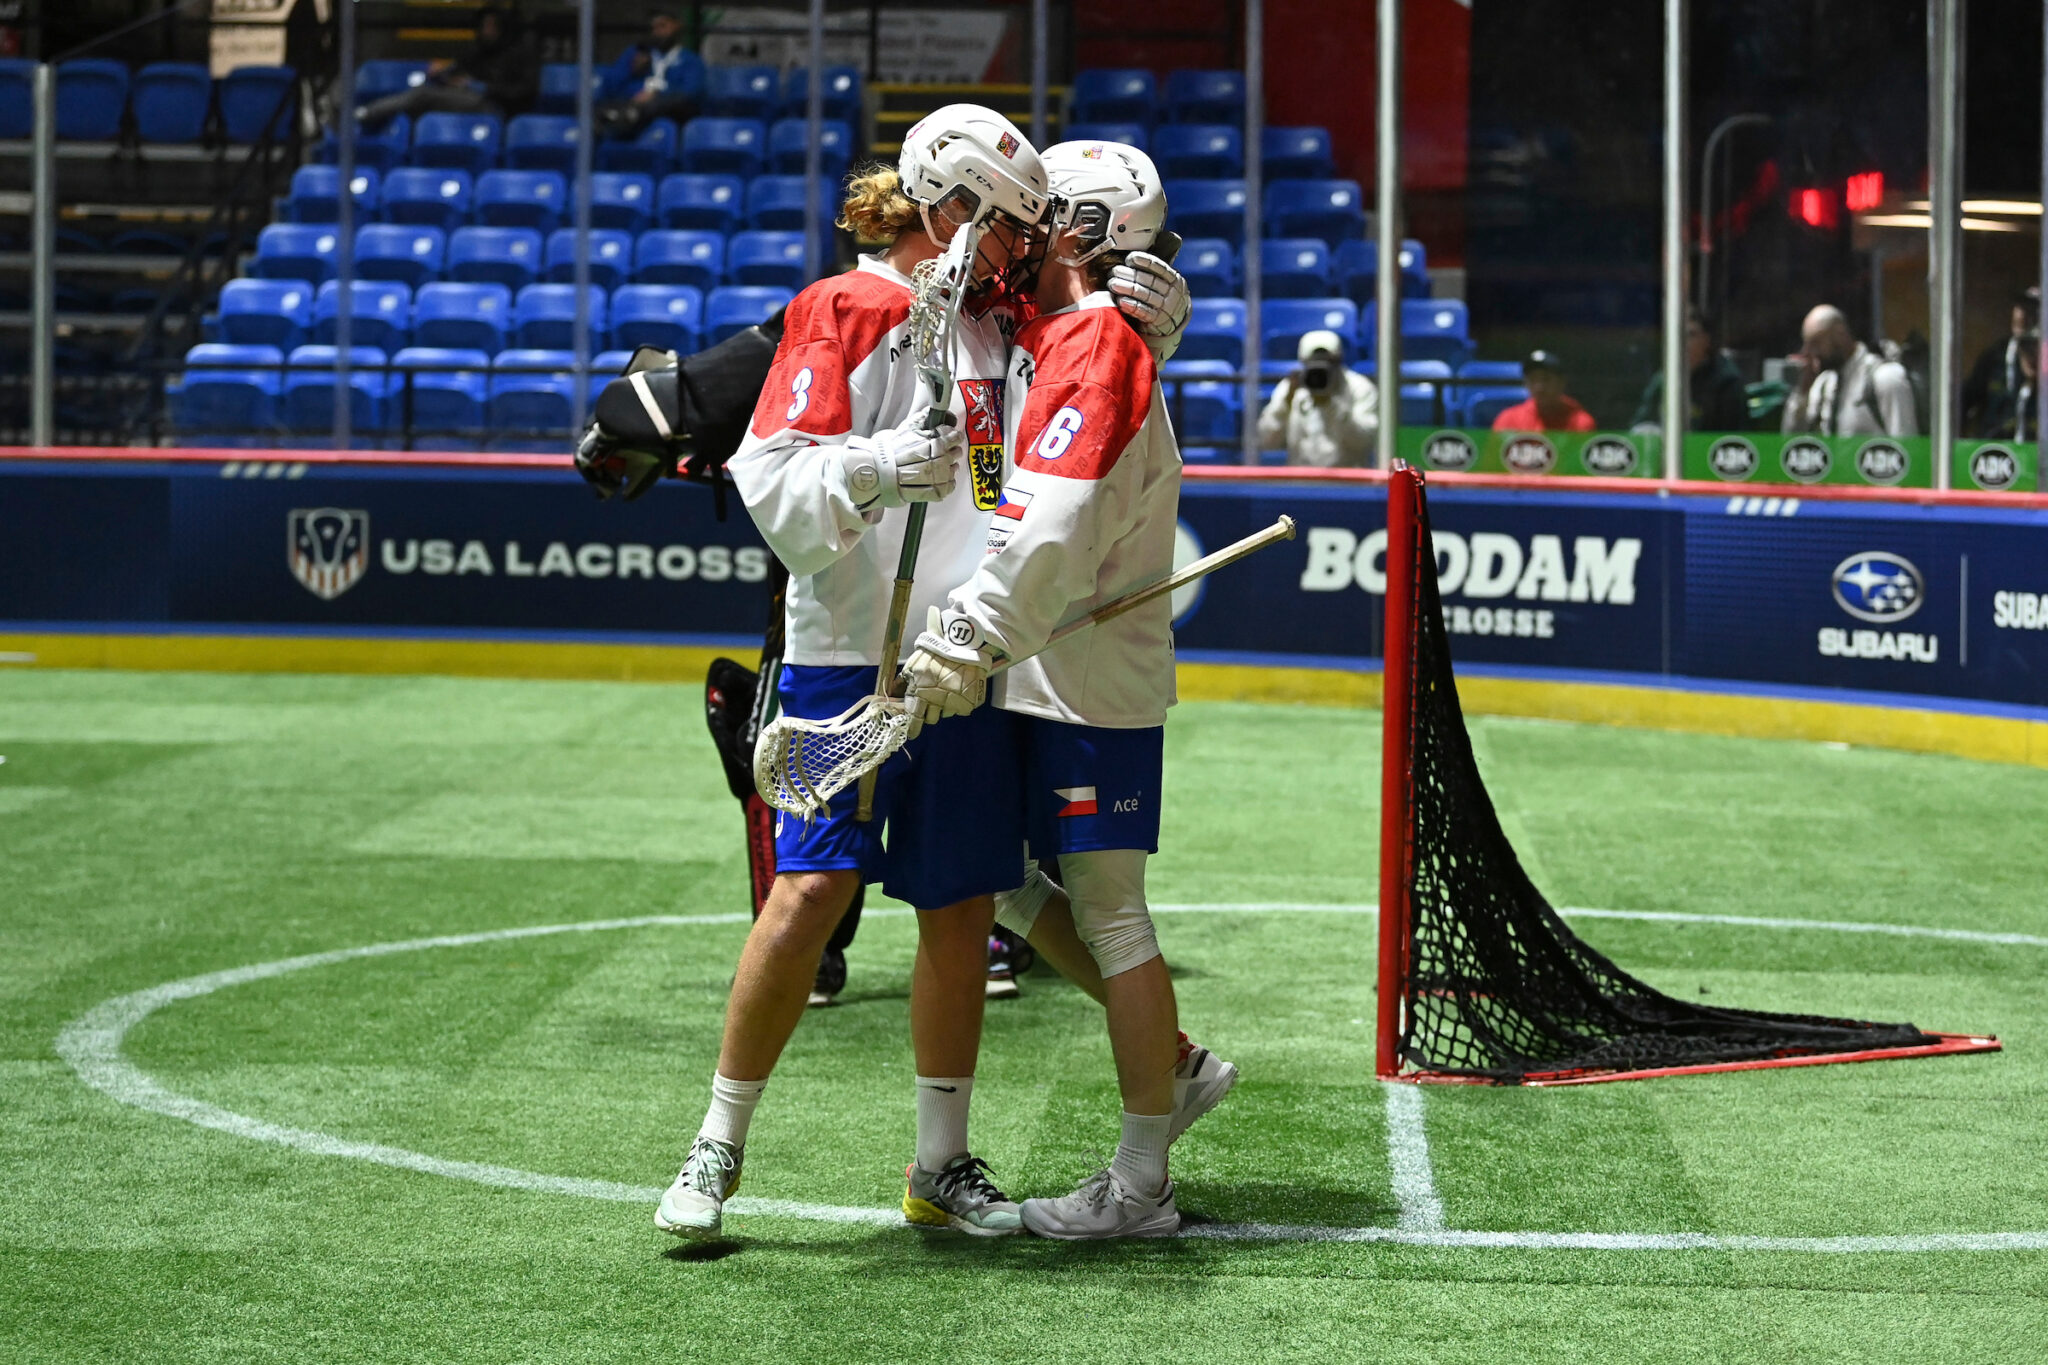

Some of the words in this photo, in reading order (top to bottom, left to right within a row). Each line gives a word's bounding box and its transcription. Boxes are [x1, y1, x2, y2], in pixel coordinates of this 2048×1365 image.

[965, 168, 994, 191] CCM
[786, 366, 813, 421] 3
[1027, 406, 1083, 460] 6
[381, 539, 494, 575] USA
[1818, 627, 1938, 663] SUBARU
